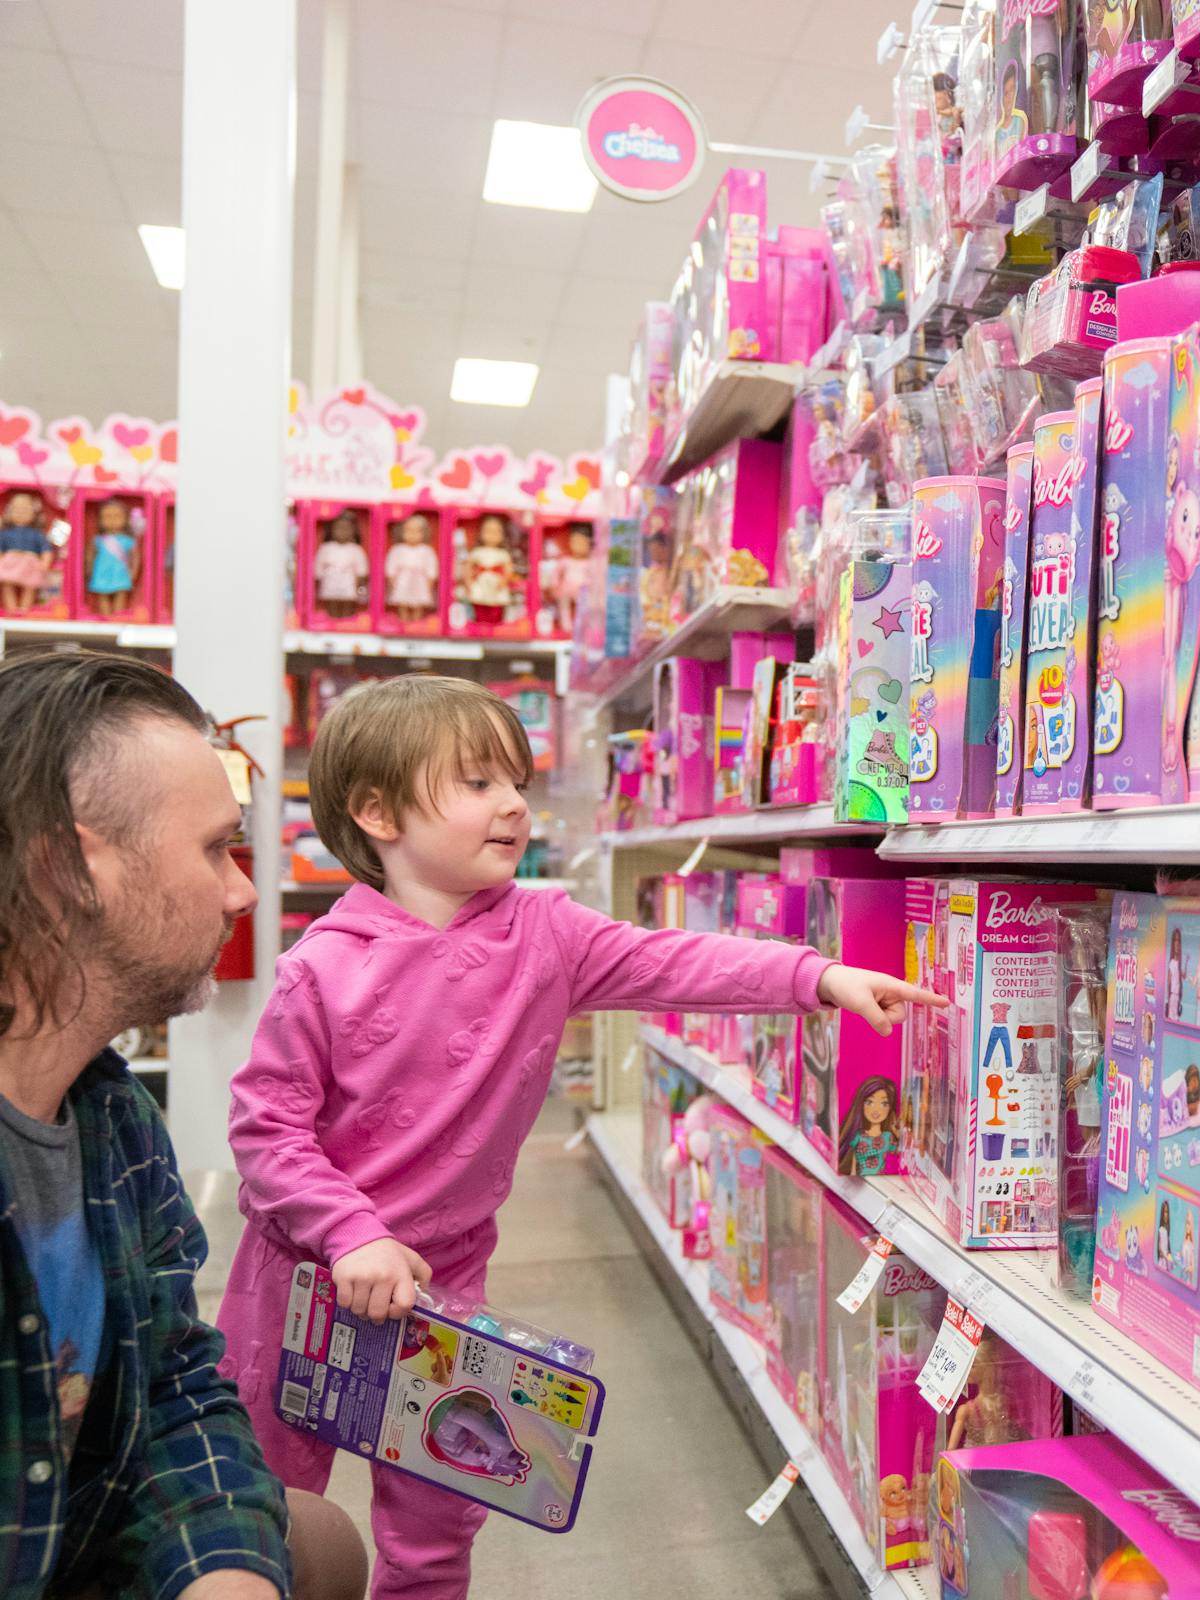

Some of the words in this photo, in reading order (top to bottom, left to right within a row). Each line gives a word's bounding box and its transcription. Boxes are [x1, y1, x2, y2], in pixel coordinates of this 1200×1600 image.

[1089, 290, 1118, 317] Bar
[1041, 665, 1064, 690] 10
[982, 934, 1019, 944] DREAM
